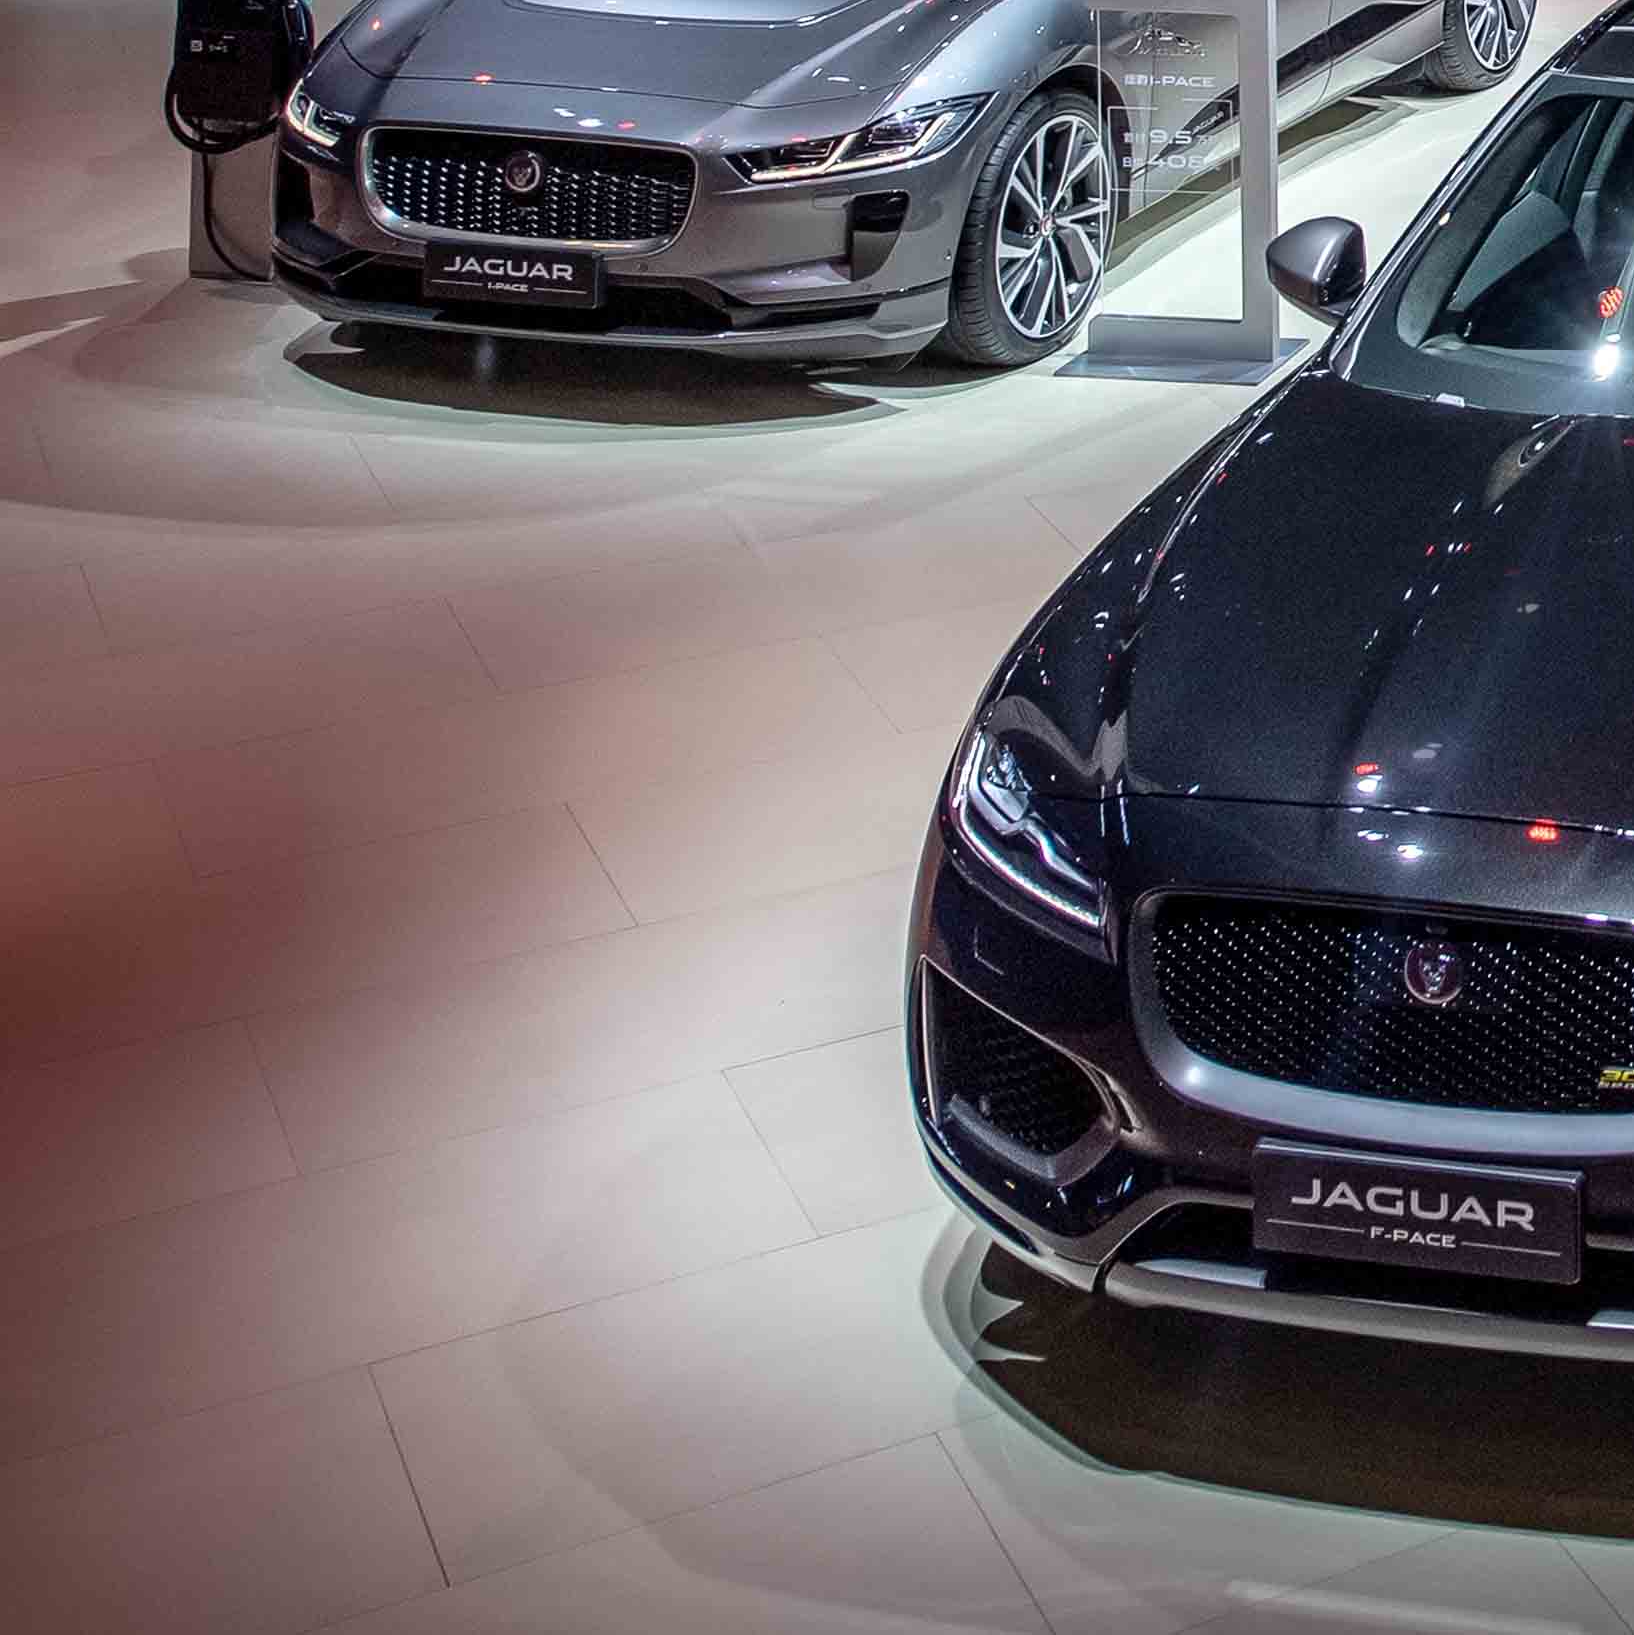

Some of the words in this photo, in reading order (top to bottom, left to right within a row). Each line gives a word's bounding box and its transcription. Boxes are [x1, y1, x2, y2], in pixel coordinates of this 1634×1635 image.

[443, 256, 574, 281] JAGUAR
[487, 281, 529, 293] I-PACE
[1290, 1177, 1536, 1233] JAGUAR
[1369, 1225, 1457, 1249] F-PACE
